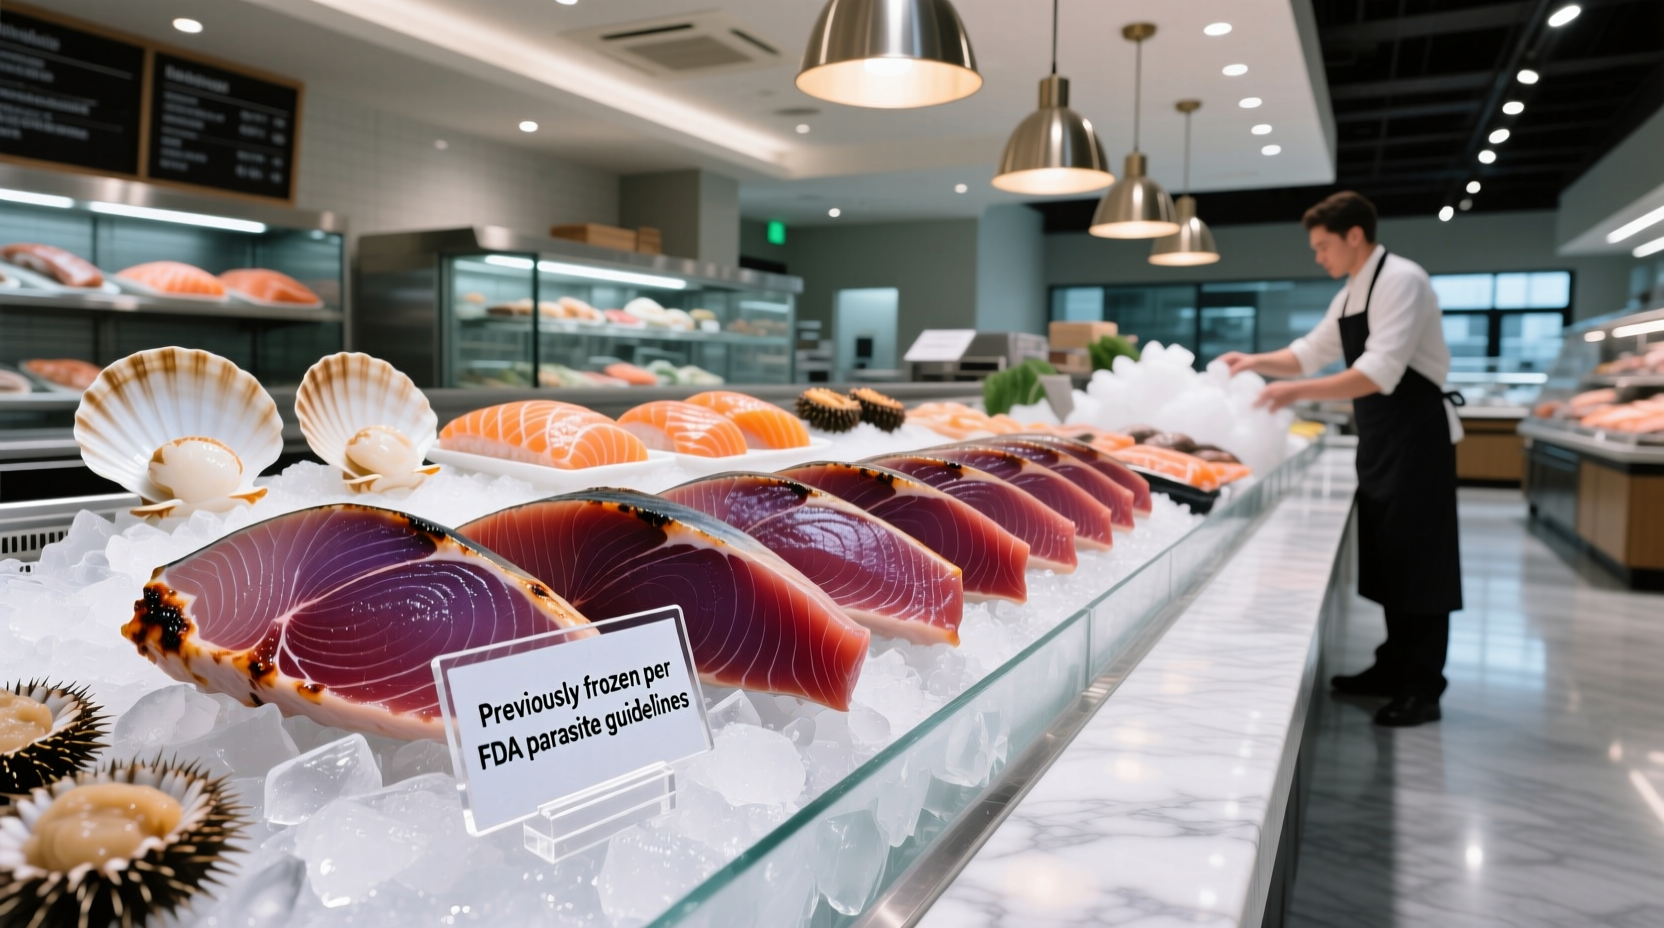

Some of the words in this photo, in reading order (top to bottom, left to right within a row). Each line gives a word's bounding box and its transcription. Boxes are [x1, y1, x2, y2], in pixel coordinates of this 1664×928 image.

[478, 736, 524, 770] FDA
[526, 715, 602, 761] parasite
[605, 691, 690, 736] guidelines
[479, 682, 580, 728] Previously
[583, 670, 641, 699] frozen
[643, 660, 671, 689] per
